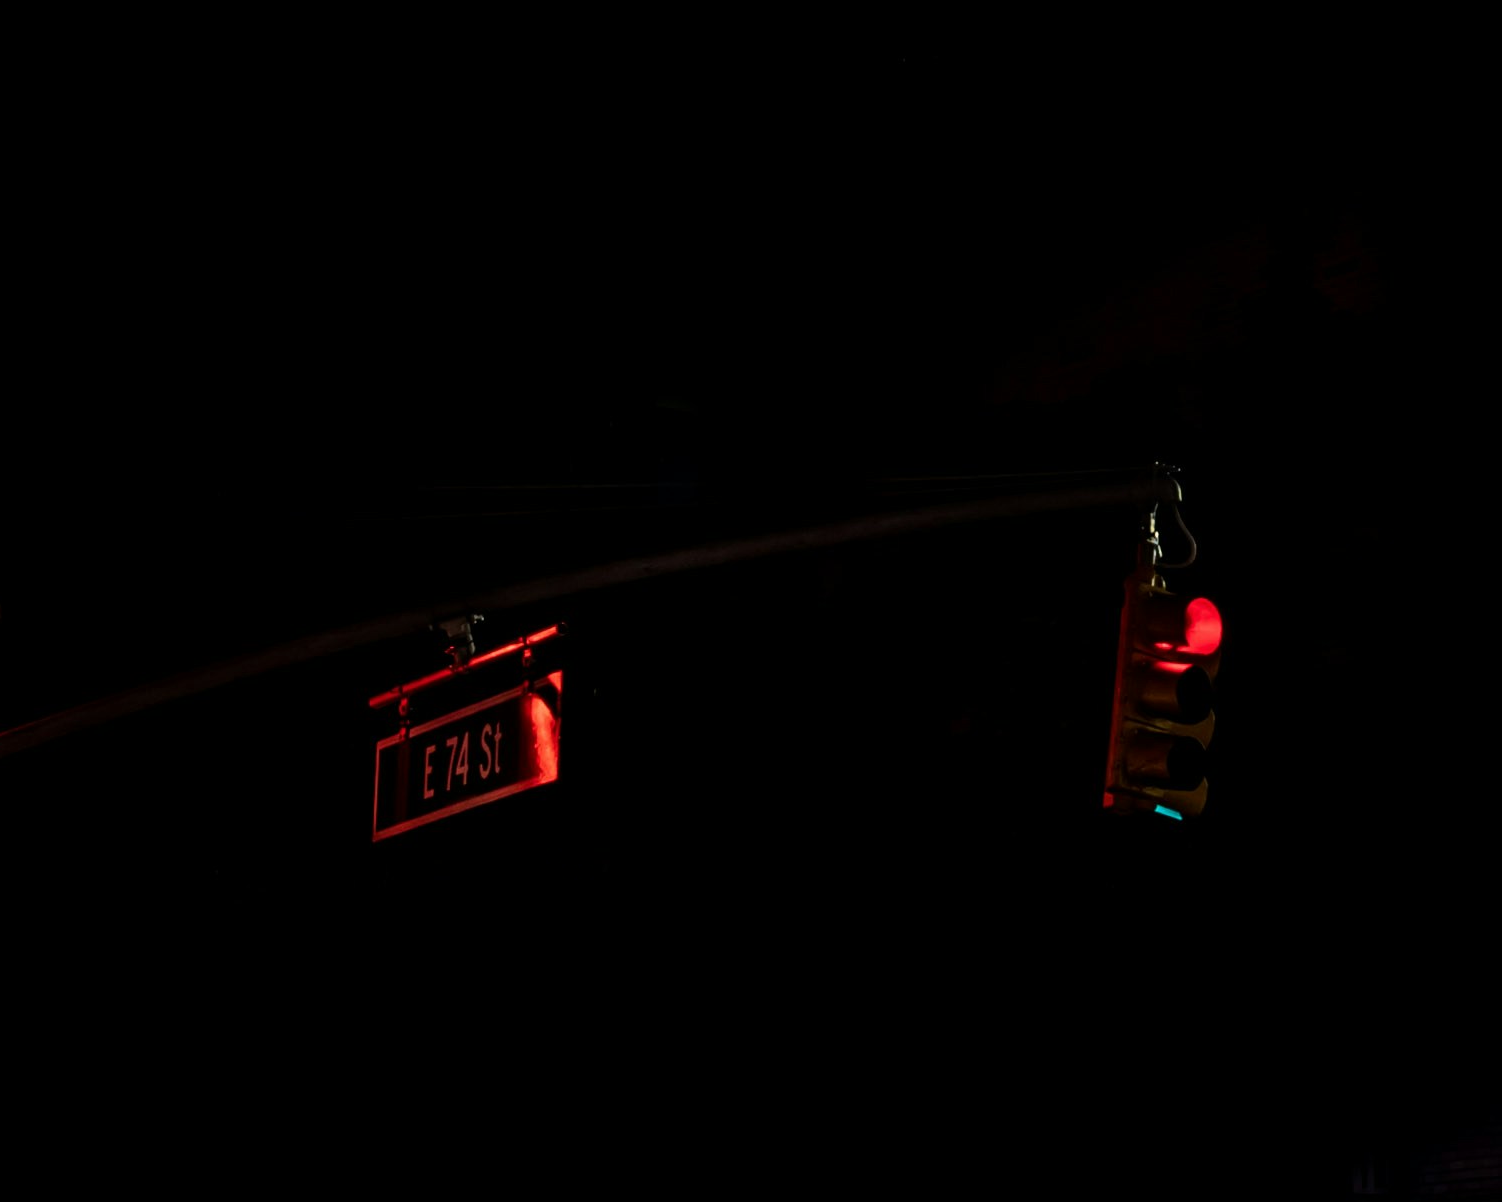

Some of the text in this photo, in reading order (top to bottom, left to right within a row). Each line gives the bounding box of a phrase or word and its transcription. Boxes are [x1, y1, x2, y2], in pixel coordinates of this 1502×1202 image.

[423, 721, 503, 800] E 74 St
